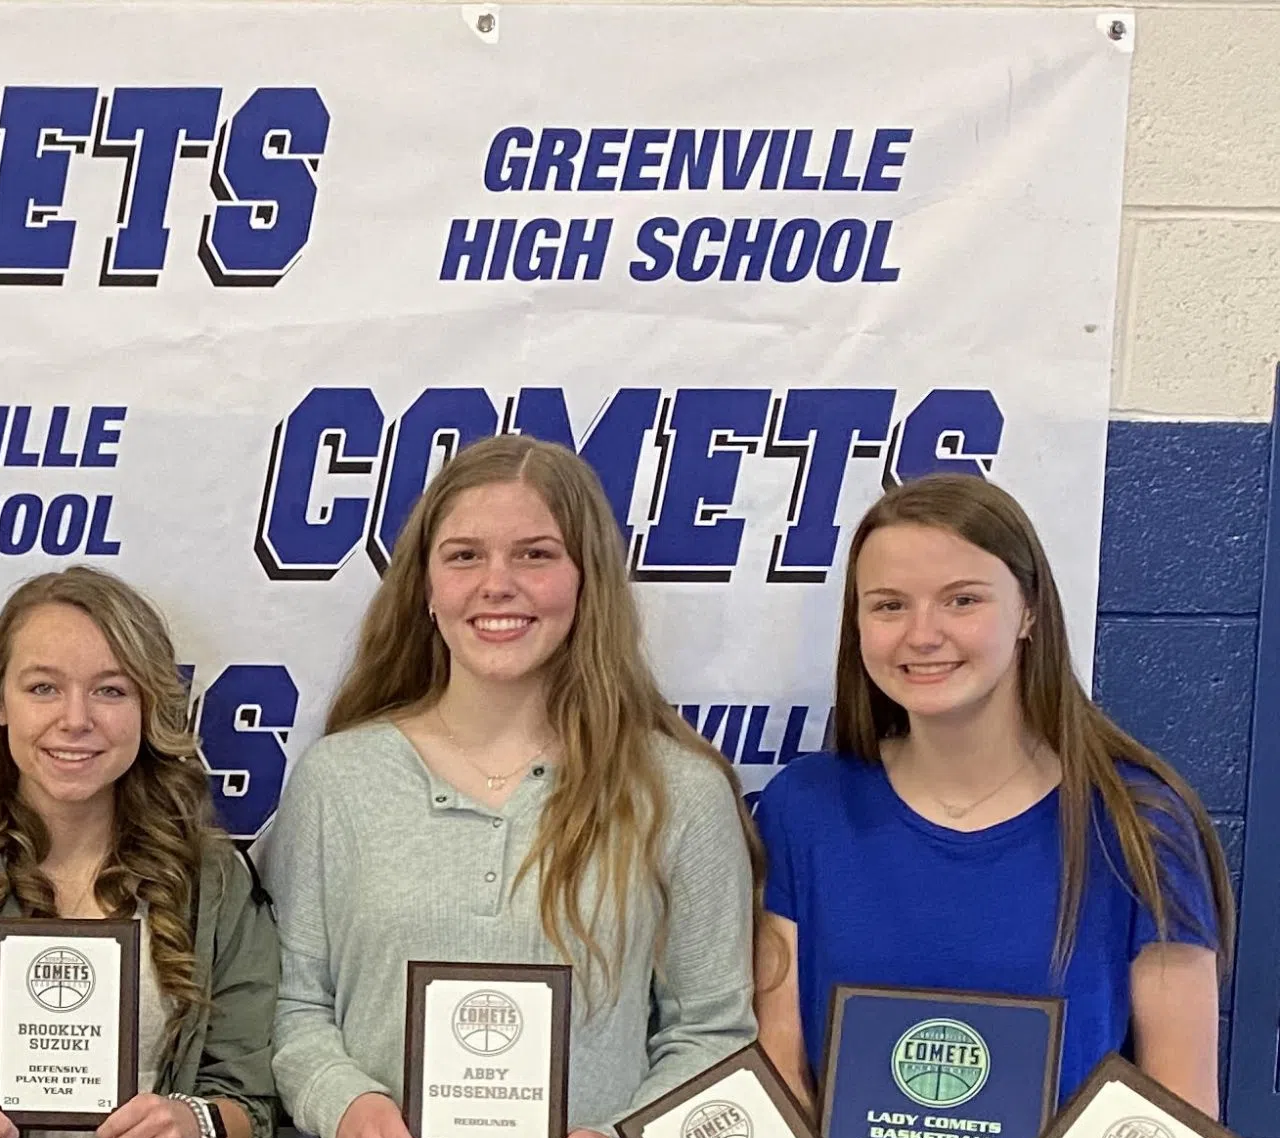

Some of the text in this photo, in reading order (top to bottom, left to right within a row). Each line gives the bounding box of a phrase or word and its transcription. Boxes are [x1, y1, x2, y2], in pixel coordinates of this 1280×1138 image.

[484, 126, 914, 192] GREENVILLE
[439, 216, 901, 283] HIGH SCHOOL
[34, 964, 89, 980] COMETS
[459, 1008, 516, 1024] COMETS
[19, 1023, 102, 1037] BROOKLYN
[29, 1038, 90, 1051] SUZUKI
[904, 1041, 980, 1065] COMETS
[29, 1065, 88, 1074] DEFENSIVE
[463, 1067, 509, 1081] ABBY
[16, 1076, 59, 1084] PLAYER
[81, 1077, 101, 1085] THE
[43, 1087, 73, 1095] YEAR
[428, 1084, 544, 1101] SUSSENBACH
[4, 1097, 112, 1107] 20 21
[454, 1117, 517, 1127] REBOUNDS
[867, 1110, 1002, 1134] LADY COMETS
